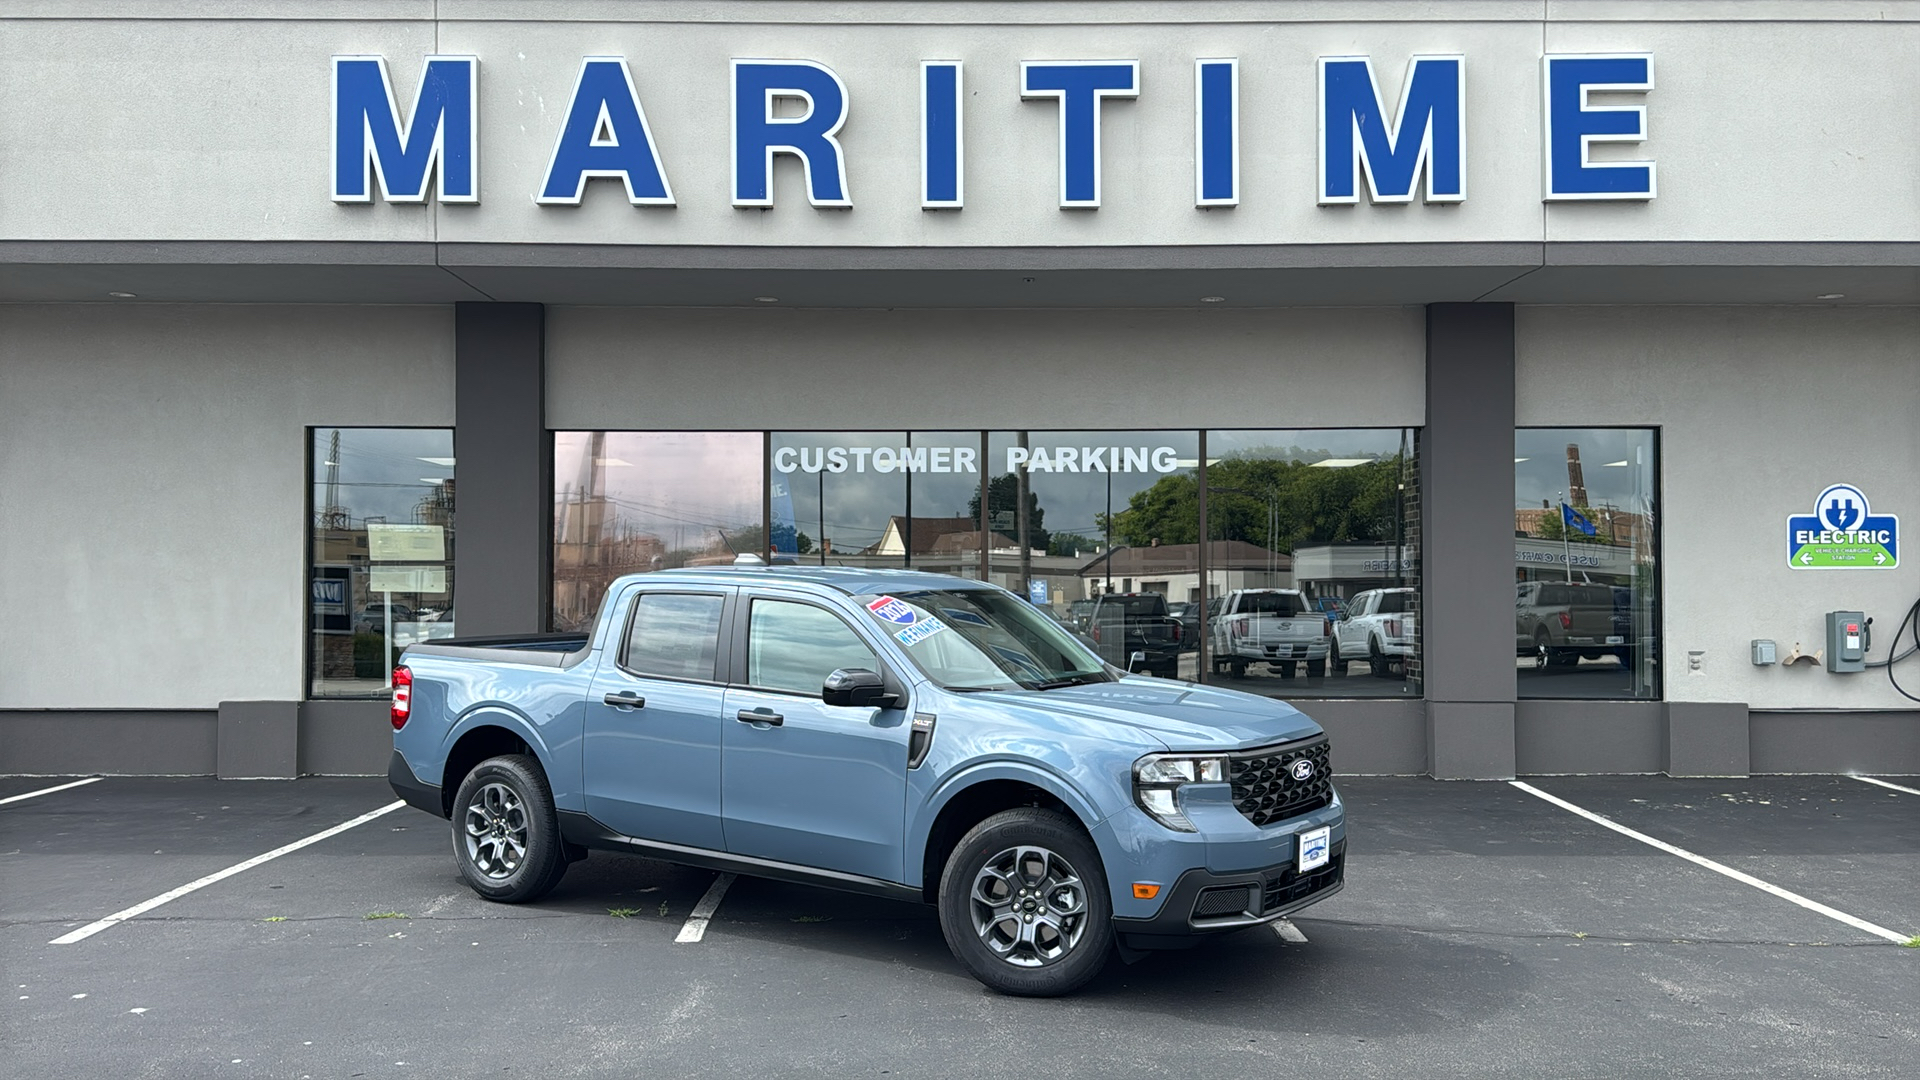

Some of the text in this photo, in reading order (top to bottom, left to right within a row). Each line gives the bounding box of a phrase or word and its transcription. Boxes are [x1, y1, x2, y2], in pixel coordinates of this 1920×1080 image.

[331, 53, 1656, 210] MARITIME
[774, 446, 1178, 473] CUSTOMER PARKING
[1796, 530, 1890, 544] ELECTRIC
[877, 601, 911, 621] 2026
[896, 616, 946, 645] WE FINANCE
[1294, 762, 1311, 778] Ford
